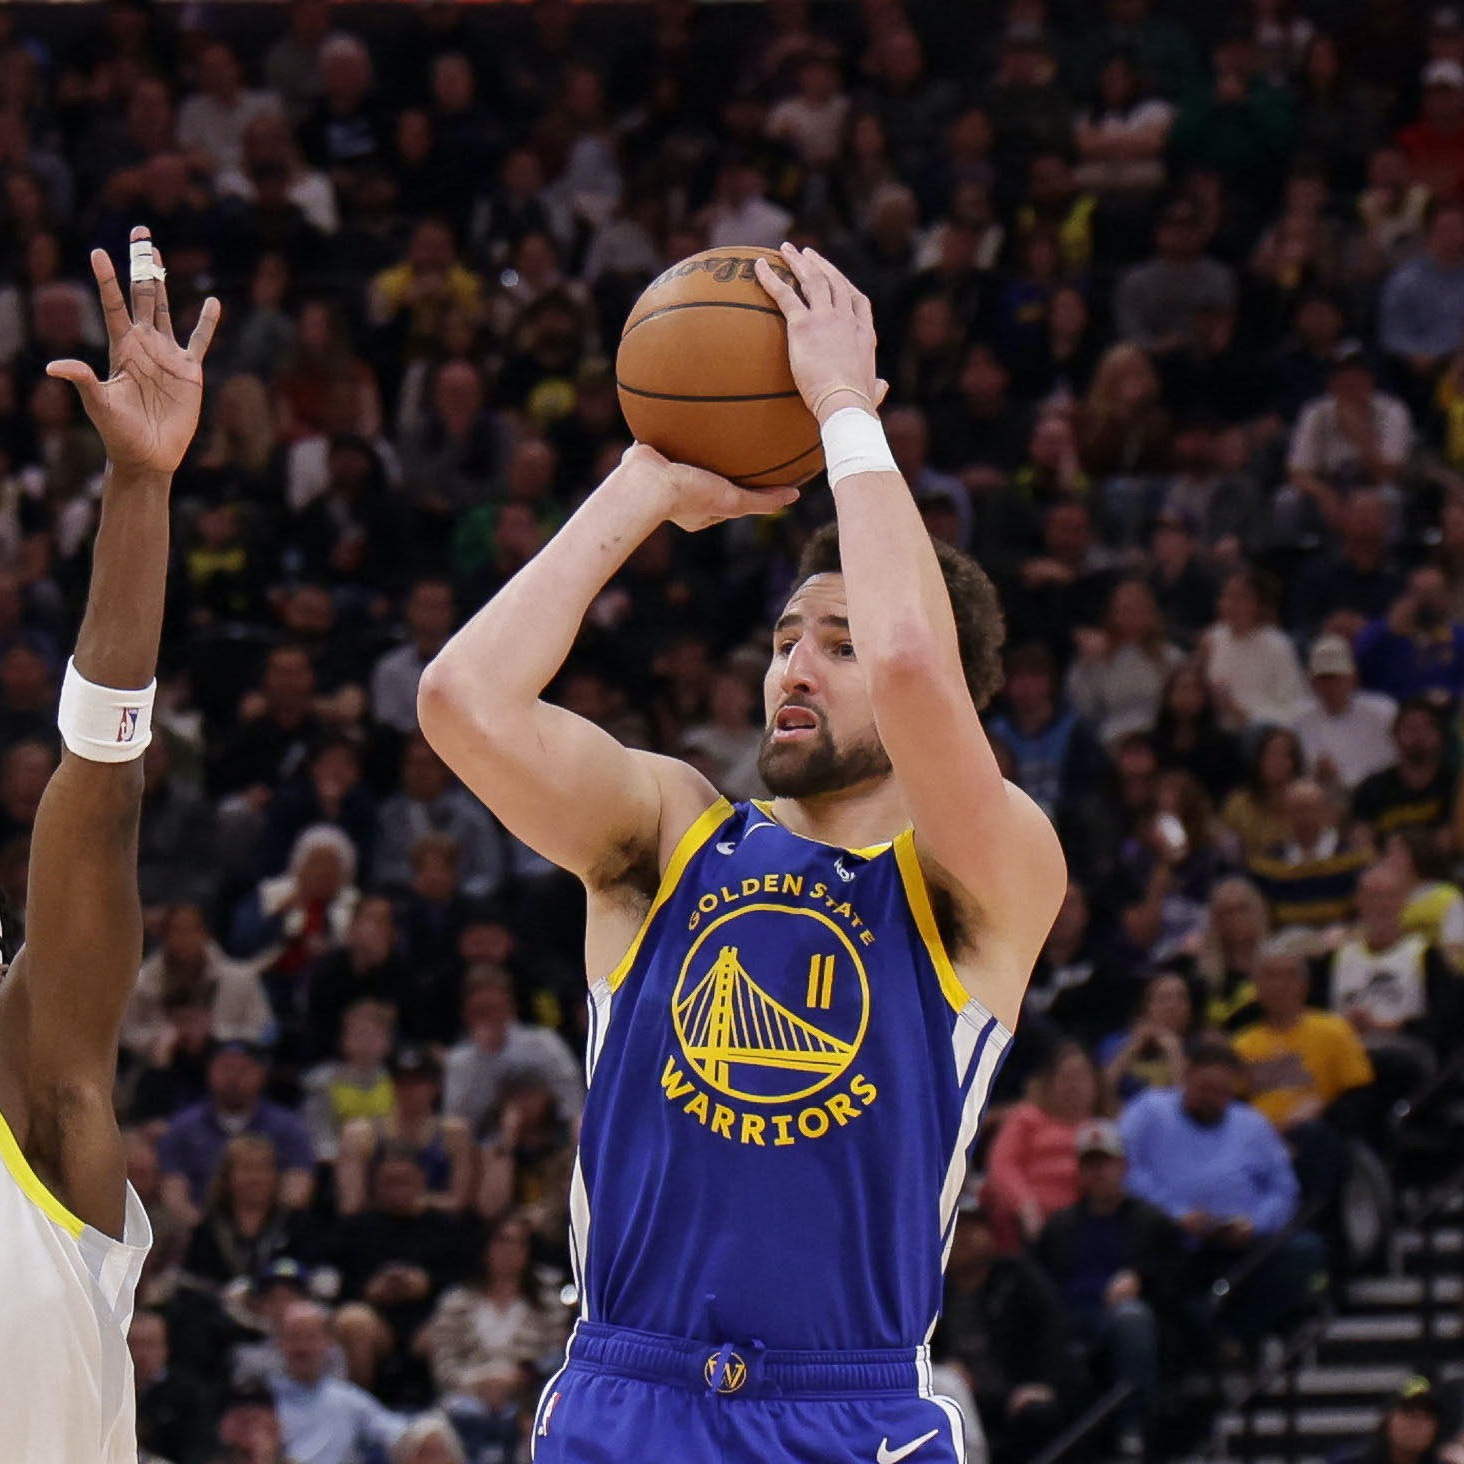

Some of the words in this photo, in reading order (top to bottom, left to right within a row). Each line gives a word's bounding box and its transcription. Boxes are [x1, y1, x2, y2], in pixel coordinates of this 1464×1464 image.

[688, 874, 805, 931] GOLDEN
[809, 882, 876, 947] STATE
[806, 953, 836, 1010] 11
[661, 1054, 878, 1147] WARRIORS
